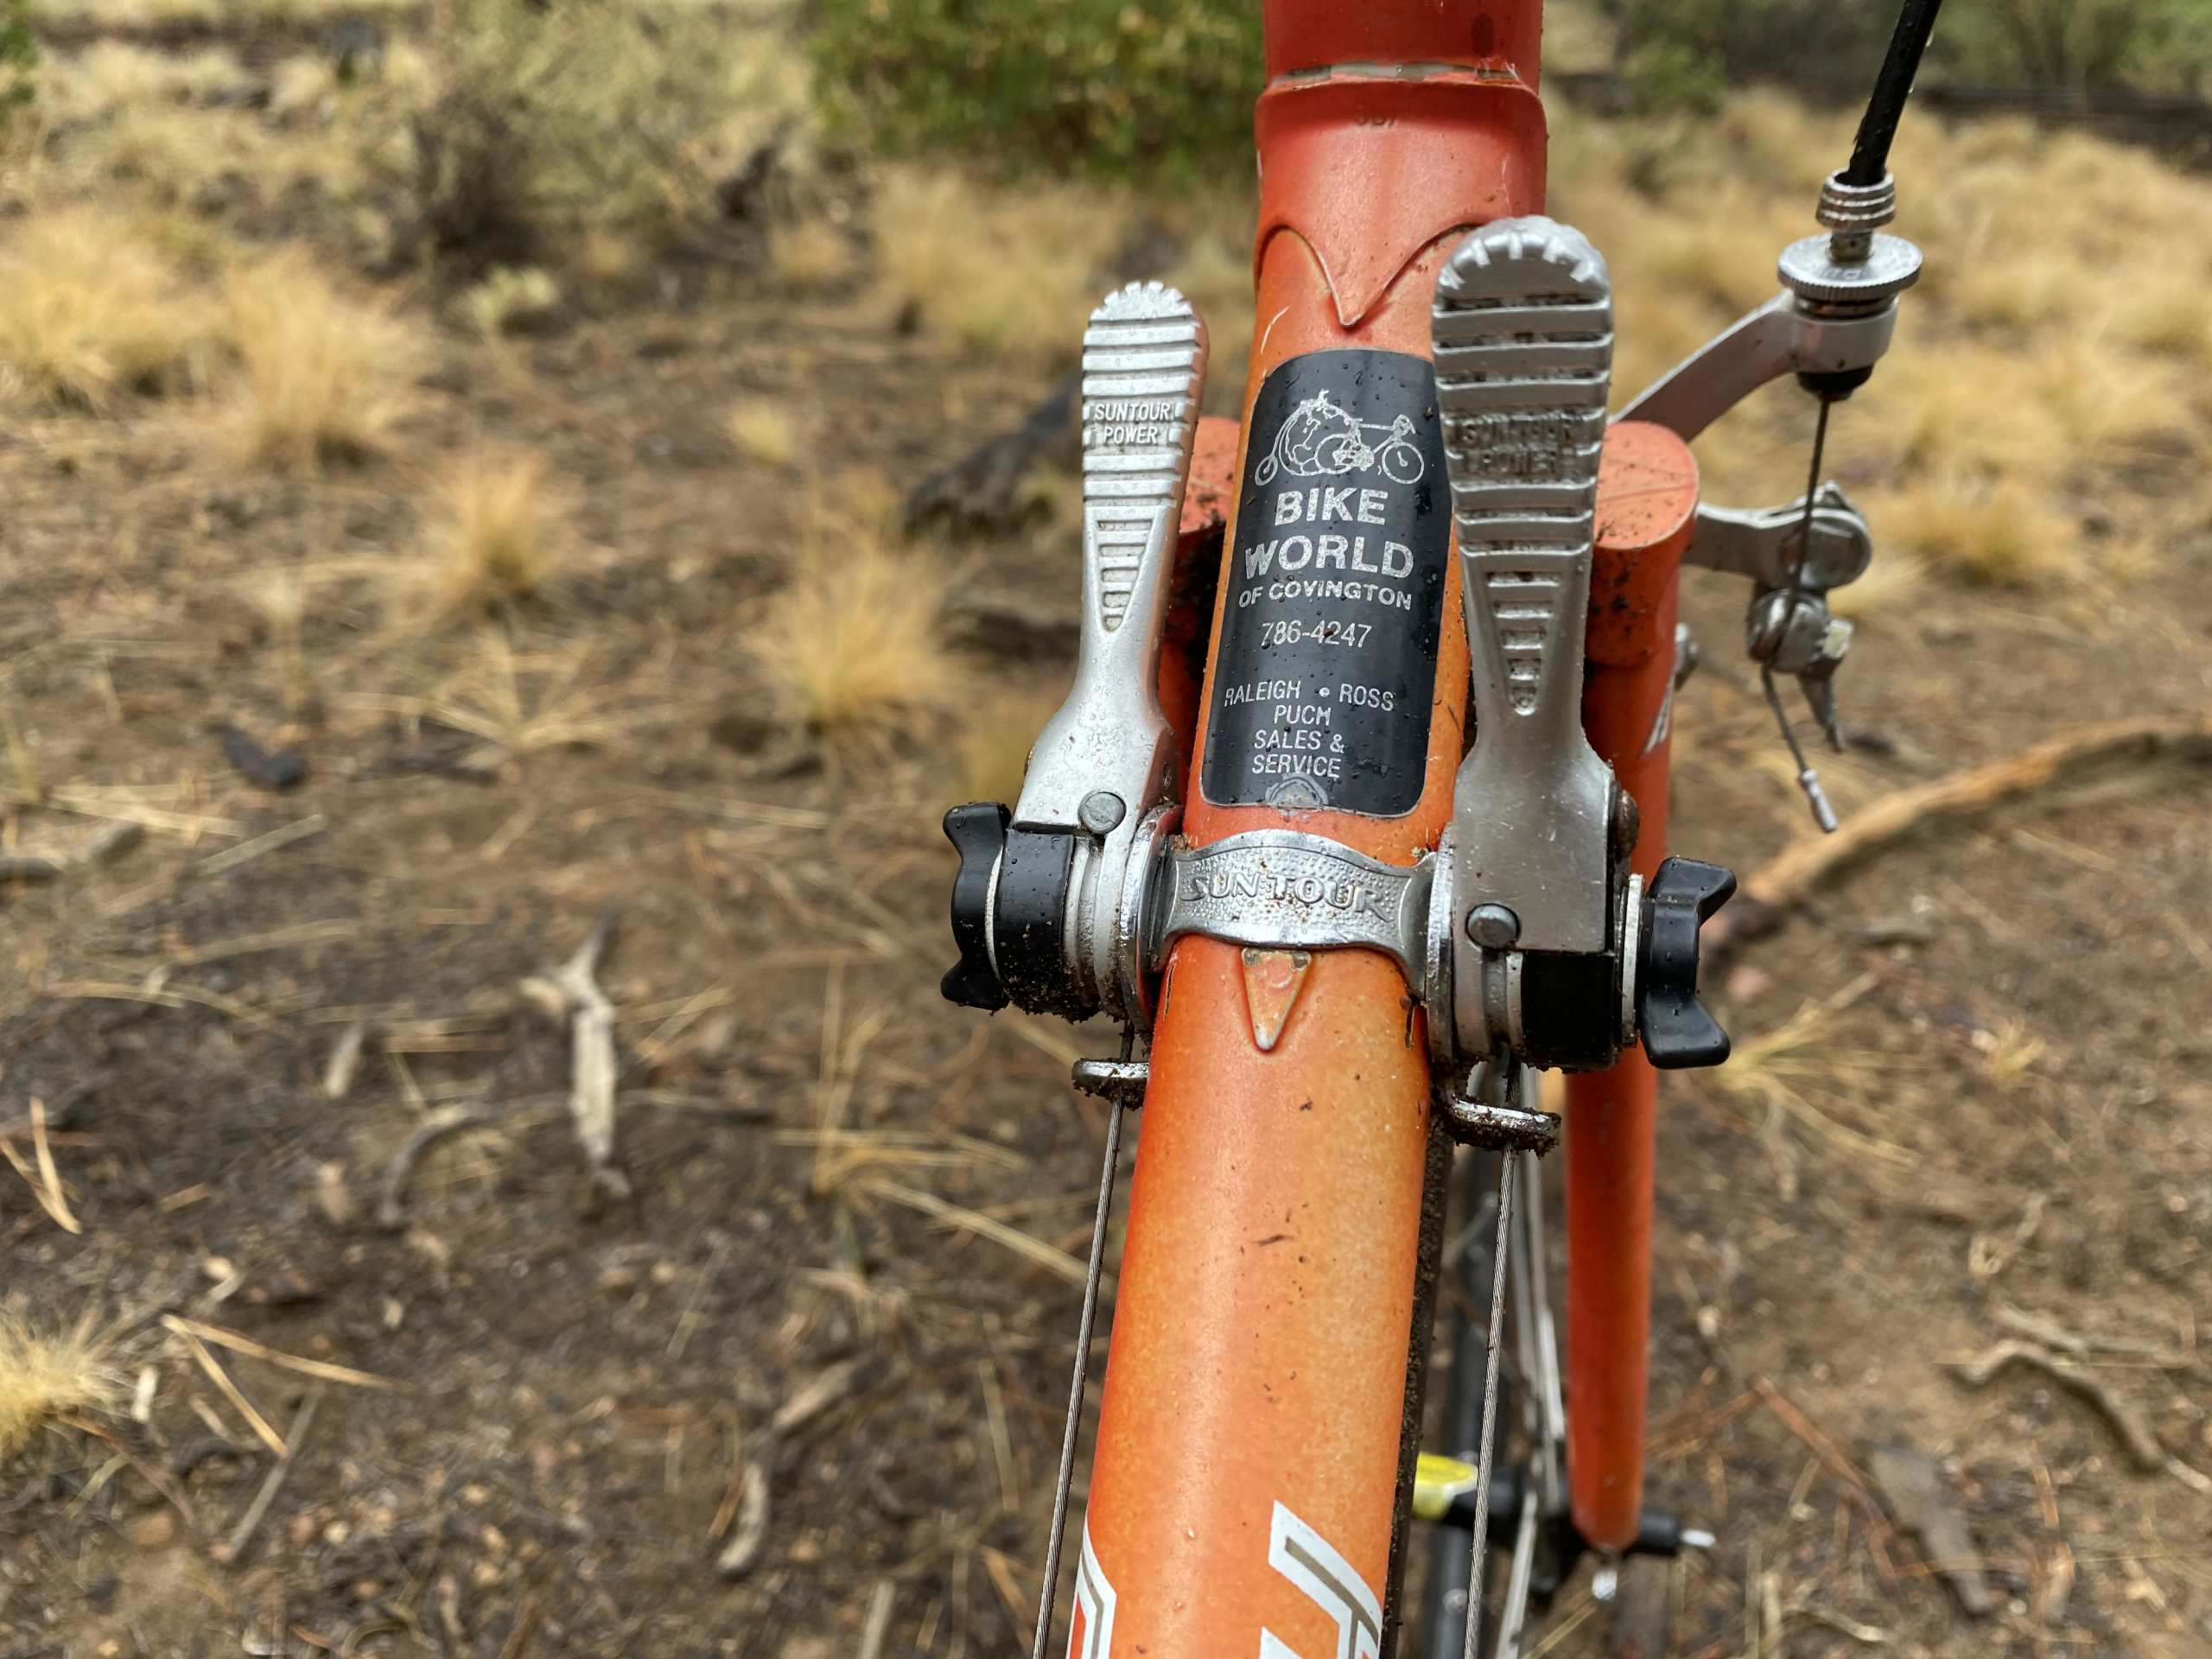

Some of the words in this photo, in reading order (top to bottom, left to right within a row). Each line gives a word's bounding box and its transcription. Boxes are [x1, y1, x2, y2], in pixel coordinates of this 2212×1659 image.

[1095, 403, 1171, 422] SUNTOUR
[1103, 425, 1159, 444] POWER
[1274, 487, 1389, 526] BIKE
[1245, 535, 1414, 580] WORLD
[1239, 586, 1263, 607] OF
[1268, 580, 1412, 610] COVINGTON
[1261, 620, 1372, 648] 786-4247
[1224, 680, 1301, 707] RALEIGH
[1339, 683, 1395, 711] ROSS
[1274, 704, 1332, 726] PUCH
[1254, 729, 1321, 750] SALES
[1330, 734, 1344, 753] &
[1252, 754, 1342, 779] SERVICE
